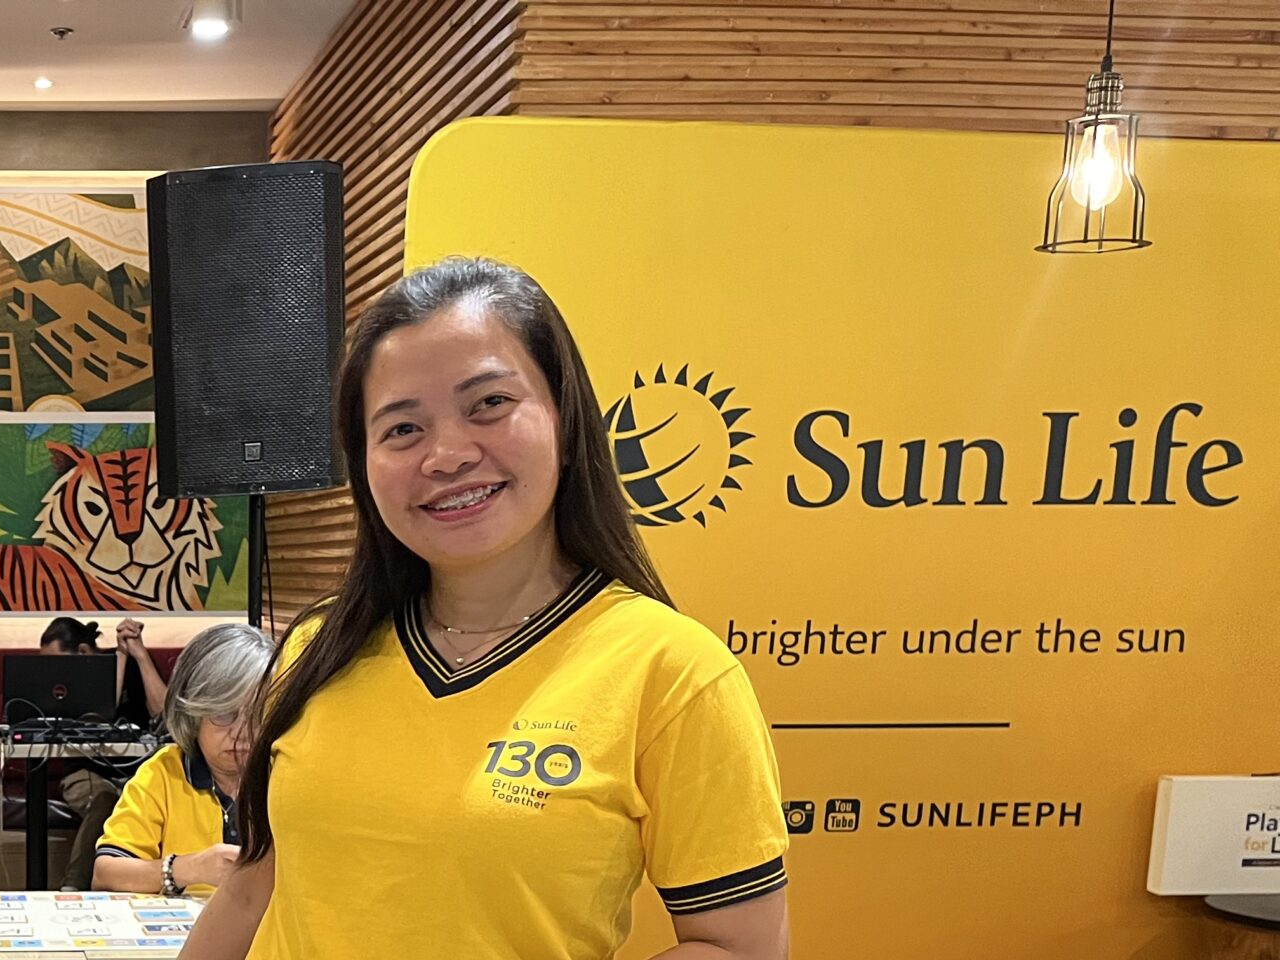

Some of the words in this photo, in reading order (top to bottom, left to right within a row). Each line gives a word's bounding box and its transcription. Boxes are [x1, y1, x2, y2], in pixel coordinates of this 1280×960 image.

[786, 408, 1007, 509] Sun
[1033, 402, 1244, 508] Life
[727, 619, 886, 666] brighter
[902, 618, 1021, 654] under
[1036, 618, 1101, 653] the
[1116, 626, 1187, 653] sun
[530, 720, 552, 730] Sun
[554, 719, 578, 731] Life
[485, 741, 582, 787] 130
[492, 779, 551, 800] Brighter
[492, 789, 546, 810] Together
[877, 802, 1082, 827] SUNLIFEPH
[1244, 836, 1269, 851] for
